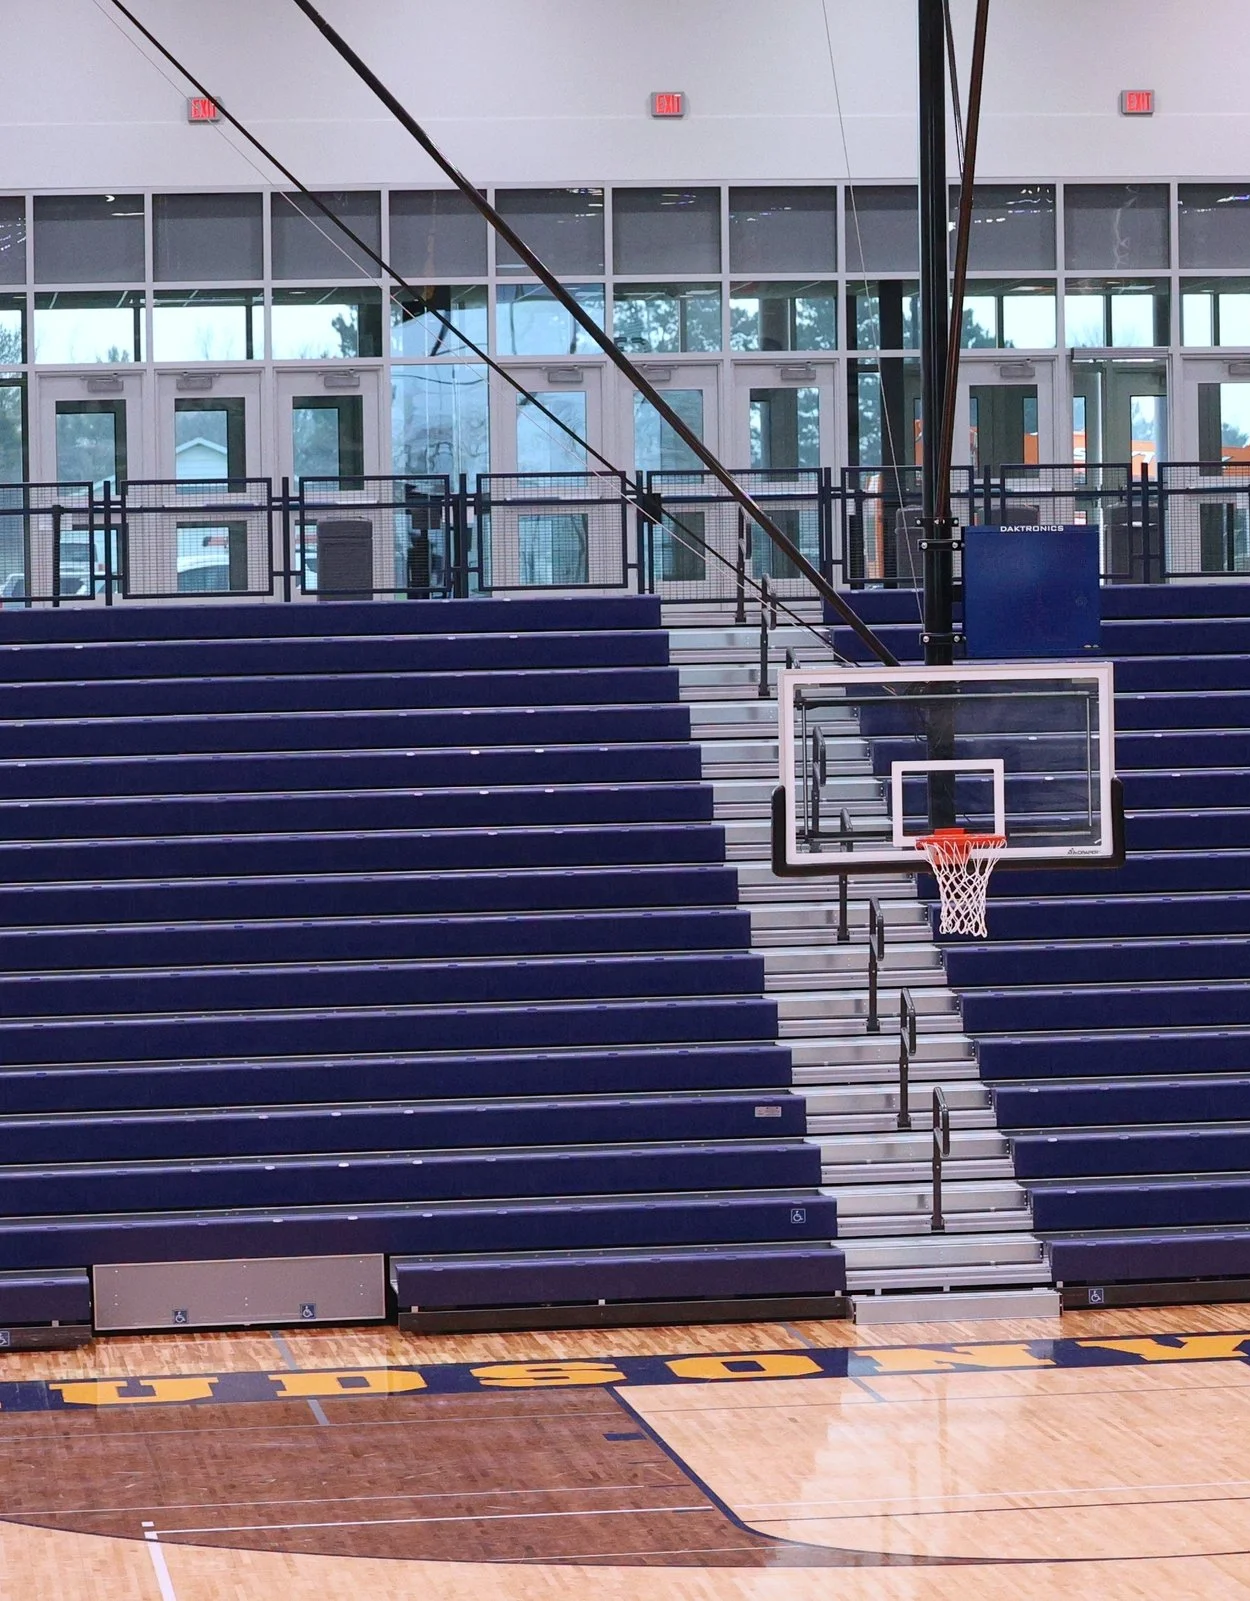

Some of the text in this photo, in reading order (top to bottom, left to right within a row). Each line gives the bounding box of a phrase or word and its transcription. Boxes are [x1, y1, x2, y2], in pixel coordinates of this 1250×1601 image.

[192, 99, 217, 118] EXIT
[656, 94, 681, 113] EXIT
[1127, 92, 1152, 111] EXIT
